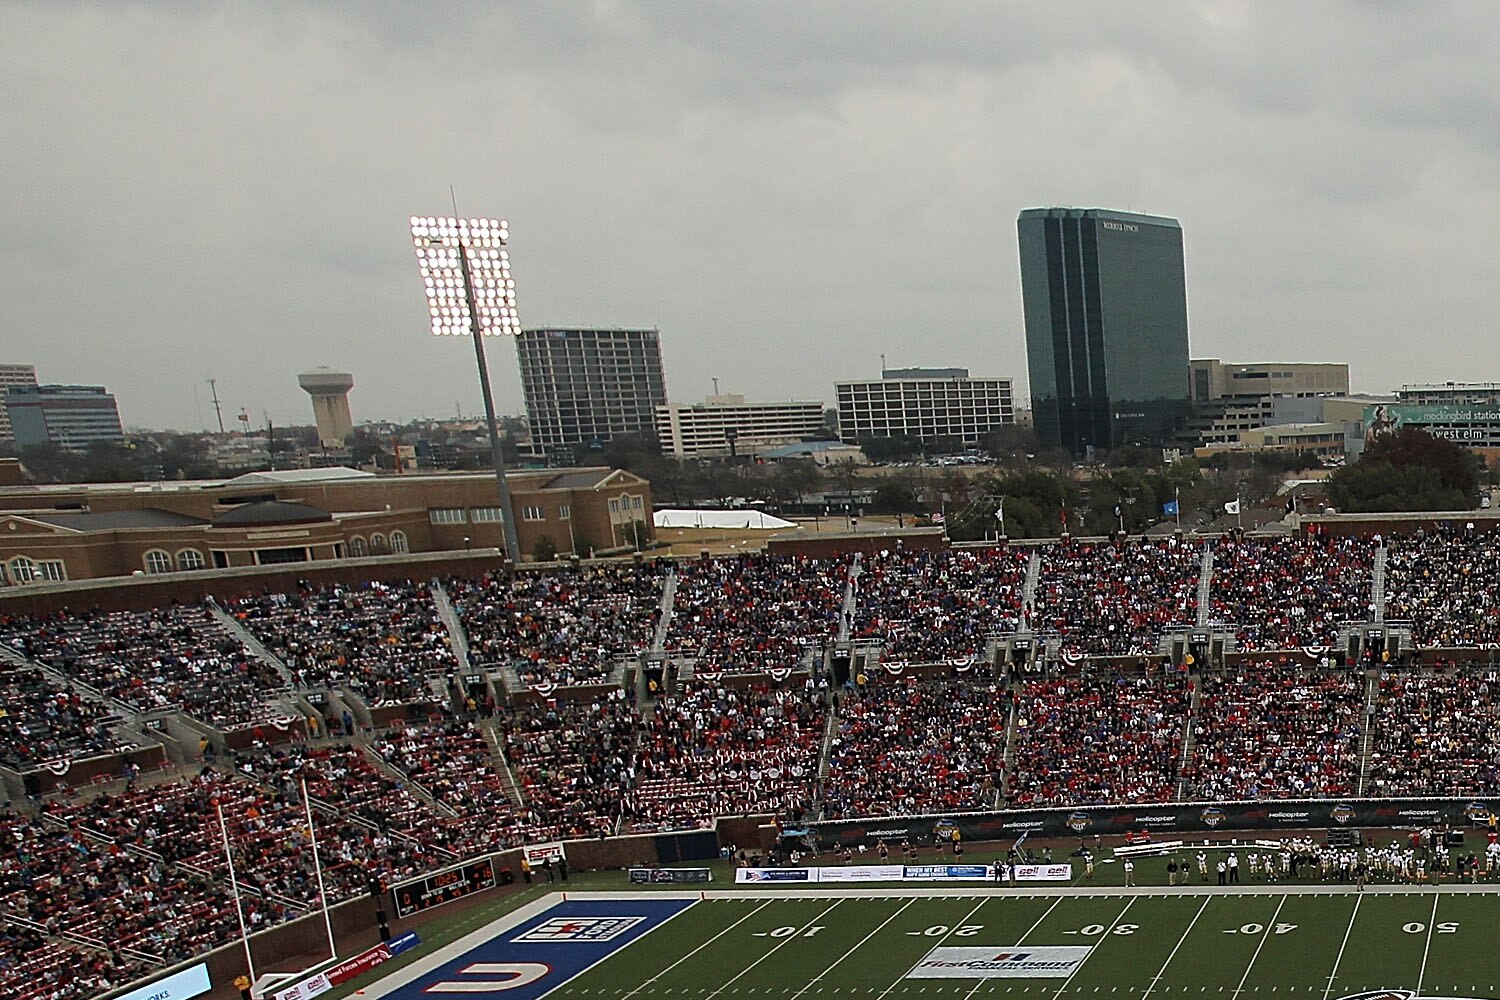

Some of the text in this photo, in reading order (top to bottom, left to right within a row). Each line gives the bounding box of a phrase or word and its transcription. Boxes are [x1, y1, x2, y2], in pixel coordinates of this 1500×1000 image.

[1424, 410, 1500, 422] mockingbird station
[1436, 429, 1482, 438] west elm
[576, 920, 620, 939] FORD
